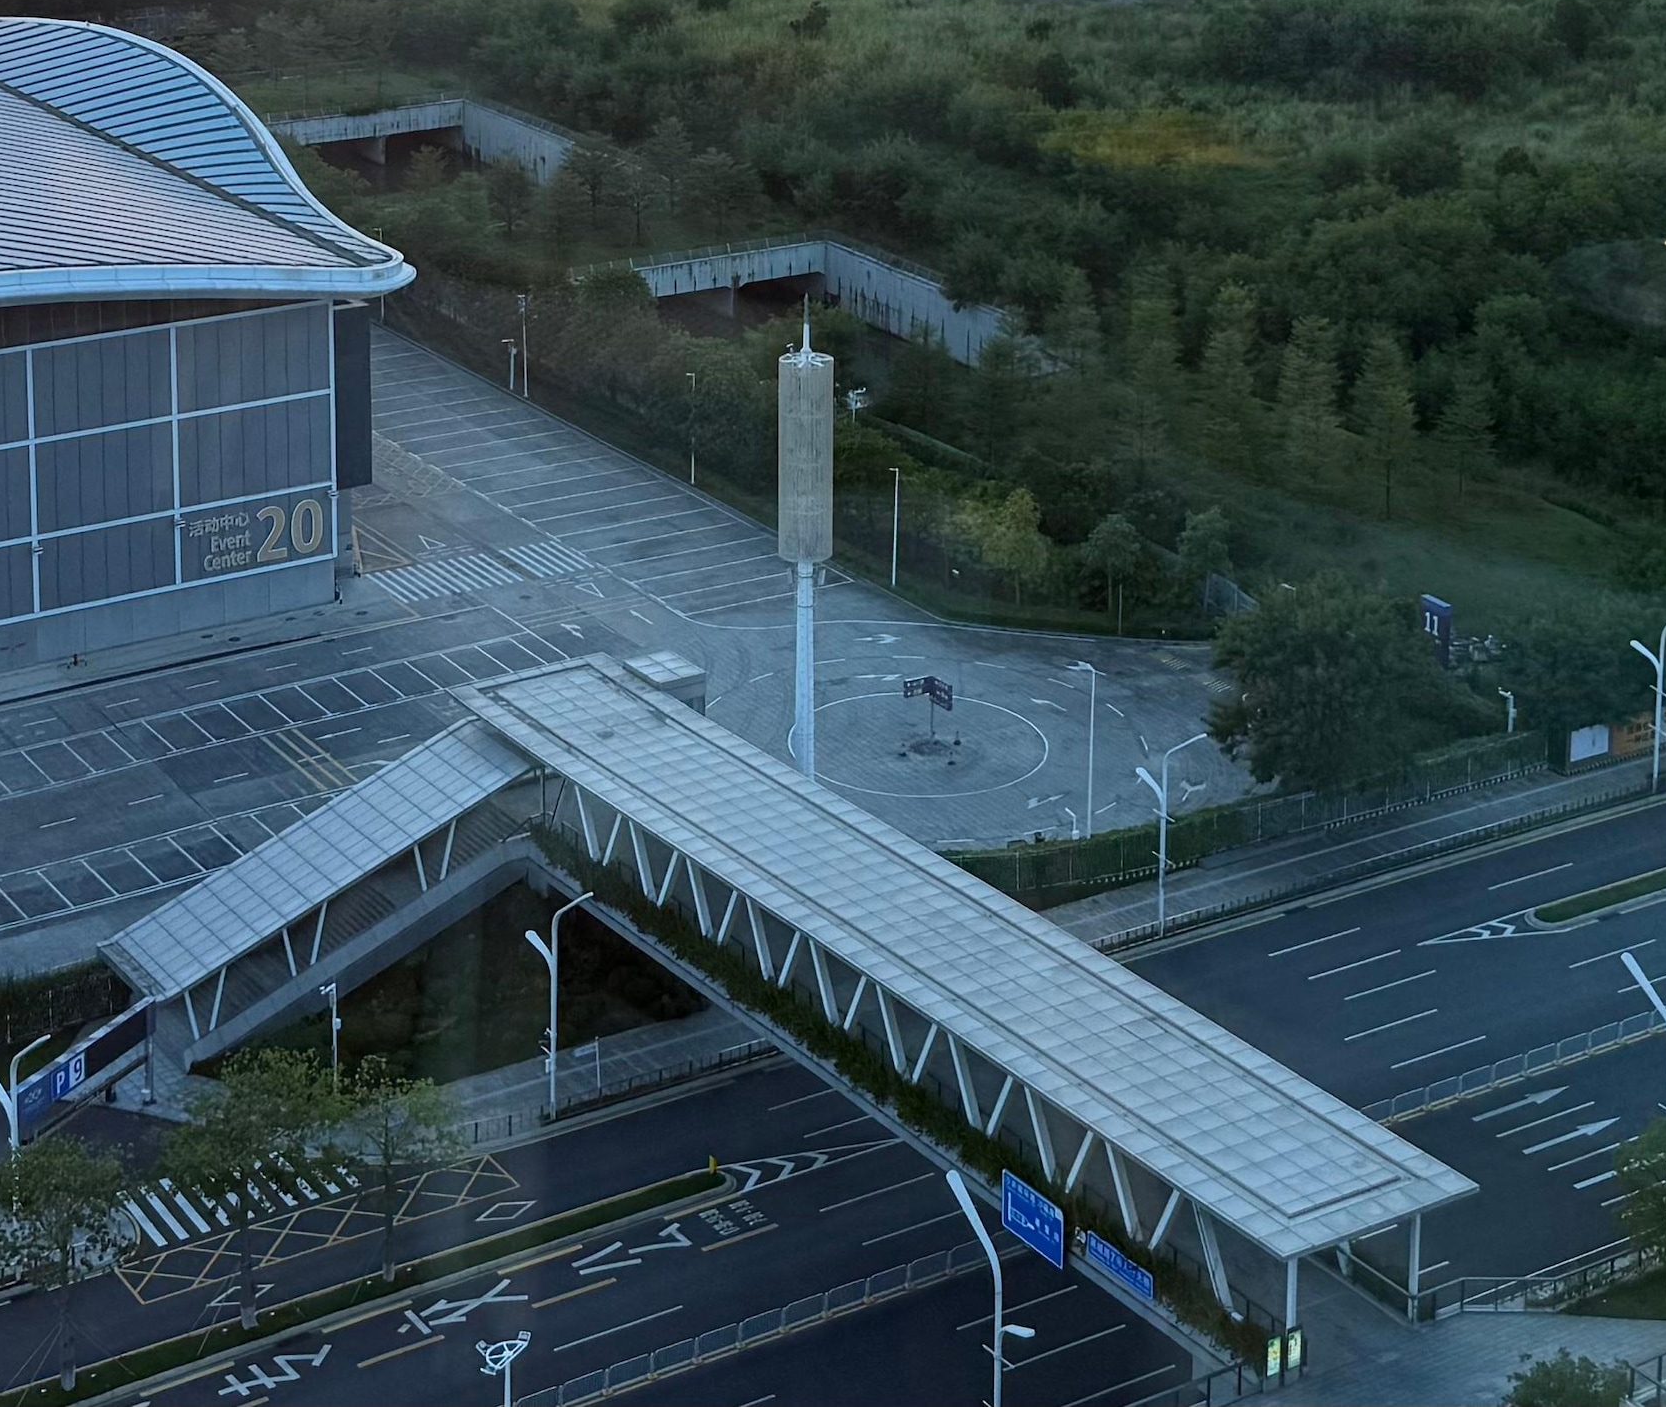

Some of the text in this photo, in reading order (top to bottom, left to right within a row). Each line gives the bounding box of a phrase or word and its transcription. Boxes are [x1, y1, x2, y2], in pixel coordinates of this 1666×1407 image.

[189, 512, 250, 537] 活动中心
[256, 498, 323, 562] 20
[211, 530, 252, 553] Event
[203, 550, 252, 571] Center
[1424, 612, 1439, 636] 11
